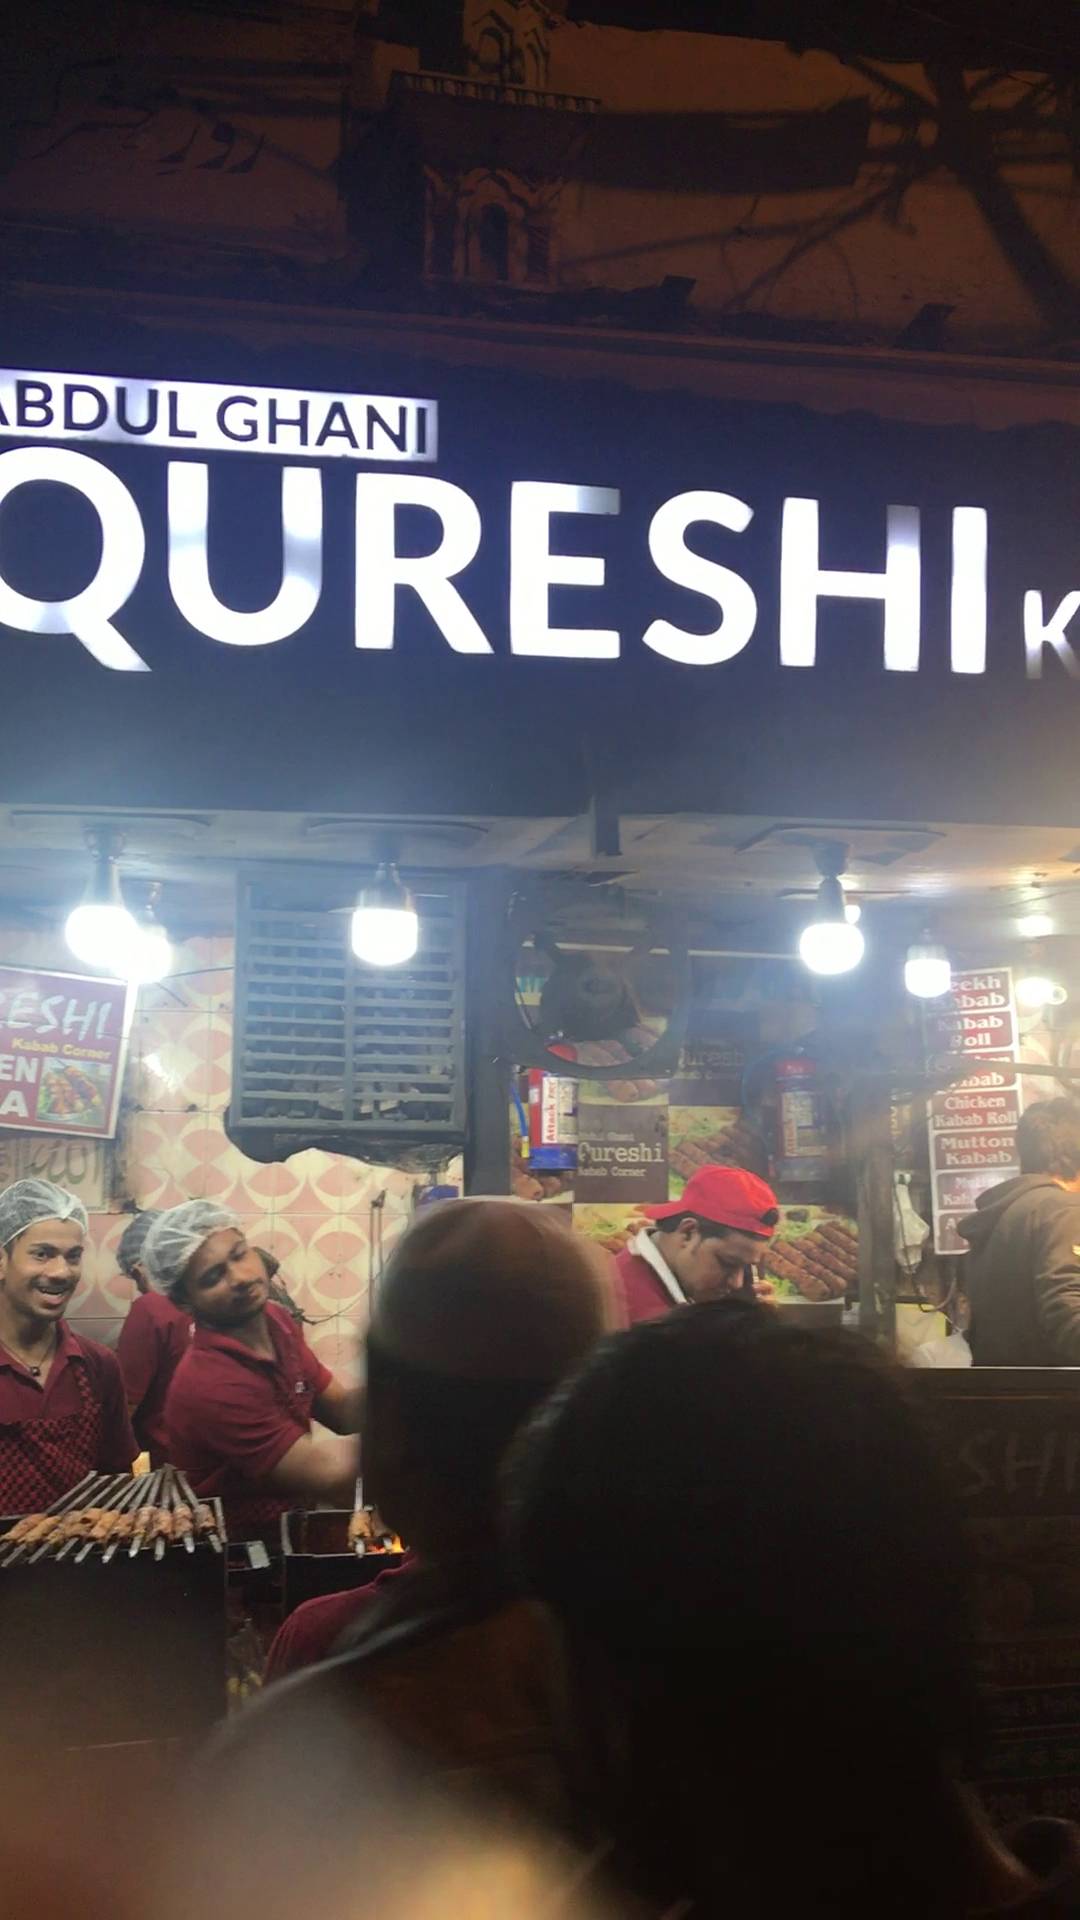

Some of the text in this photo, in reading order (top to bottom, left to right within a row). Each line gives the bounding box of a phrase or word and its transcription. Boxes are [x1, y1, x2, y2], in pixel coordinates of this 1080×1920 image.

[0, 379, 427, 455] BDUL GHANI
[0, 446, 1080, 679] QURESHI K
[950, 976, 1002, 992] eekh
[0, 990, 112, 1040] ESHI
[12, 1037, 112, 1059] Kabab Corner
[950, 1072, 1005, 1088] bab
[944, 1096, 1006, 1110] Chicken
[935, 1111, 1018, 1128] Kabab Roll
[941, 1136, 1015, 1150] Mutton
[945, 1150, 1013, 1166] Kabab
